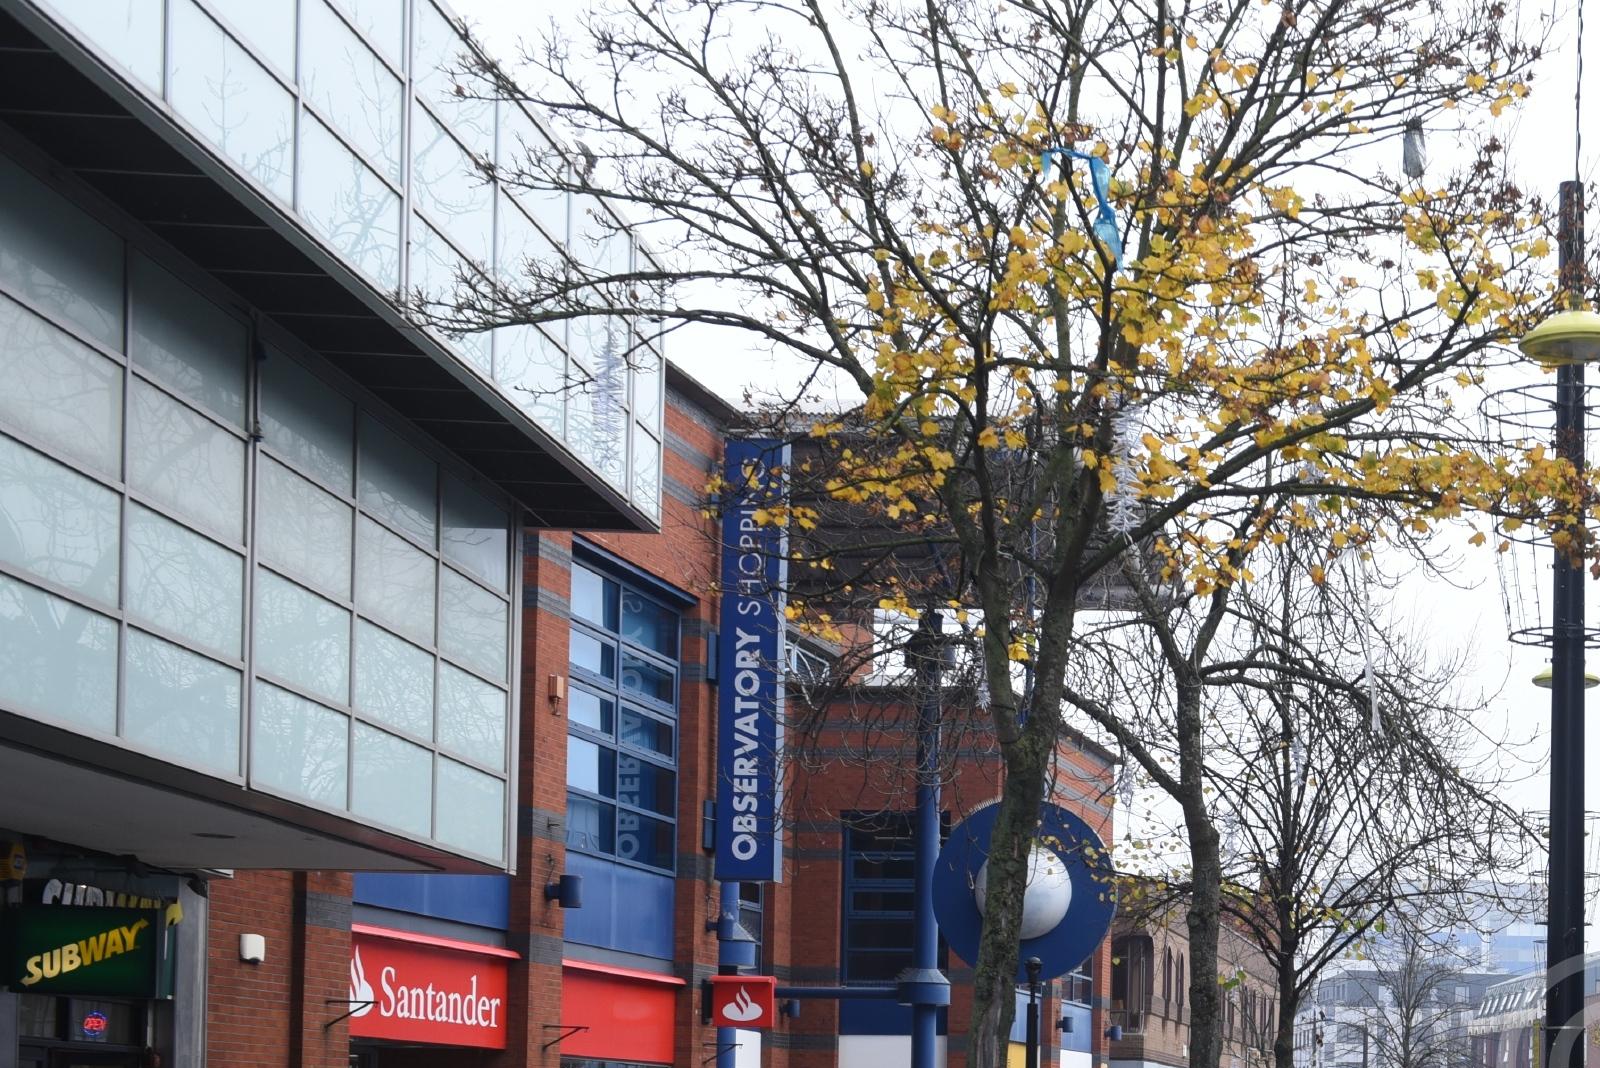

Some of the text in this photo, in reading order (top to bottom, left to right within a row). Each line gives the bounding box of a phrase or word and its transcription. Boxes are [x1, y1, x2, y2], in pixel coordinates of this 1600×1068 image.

[731, 627, 763, 861] OBSERVATORY
[20, 918, 149, 987] SUBWAY
[380, 966, 500, 1028] Santander
